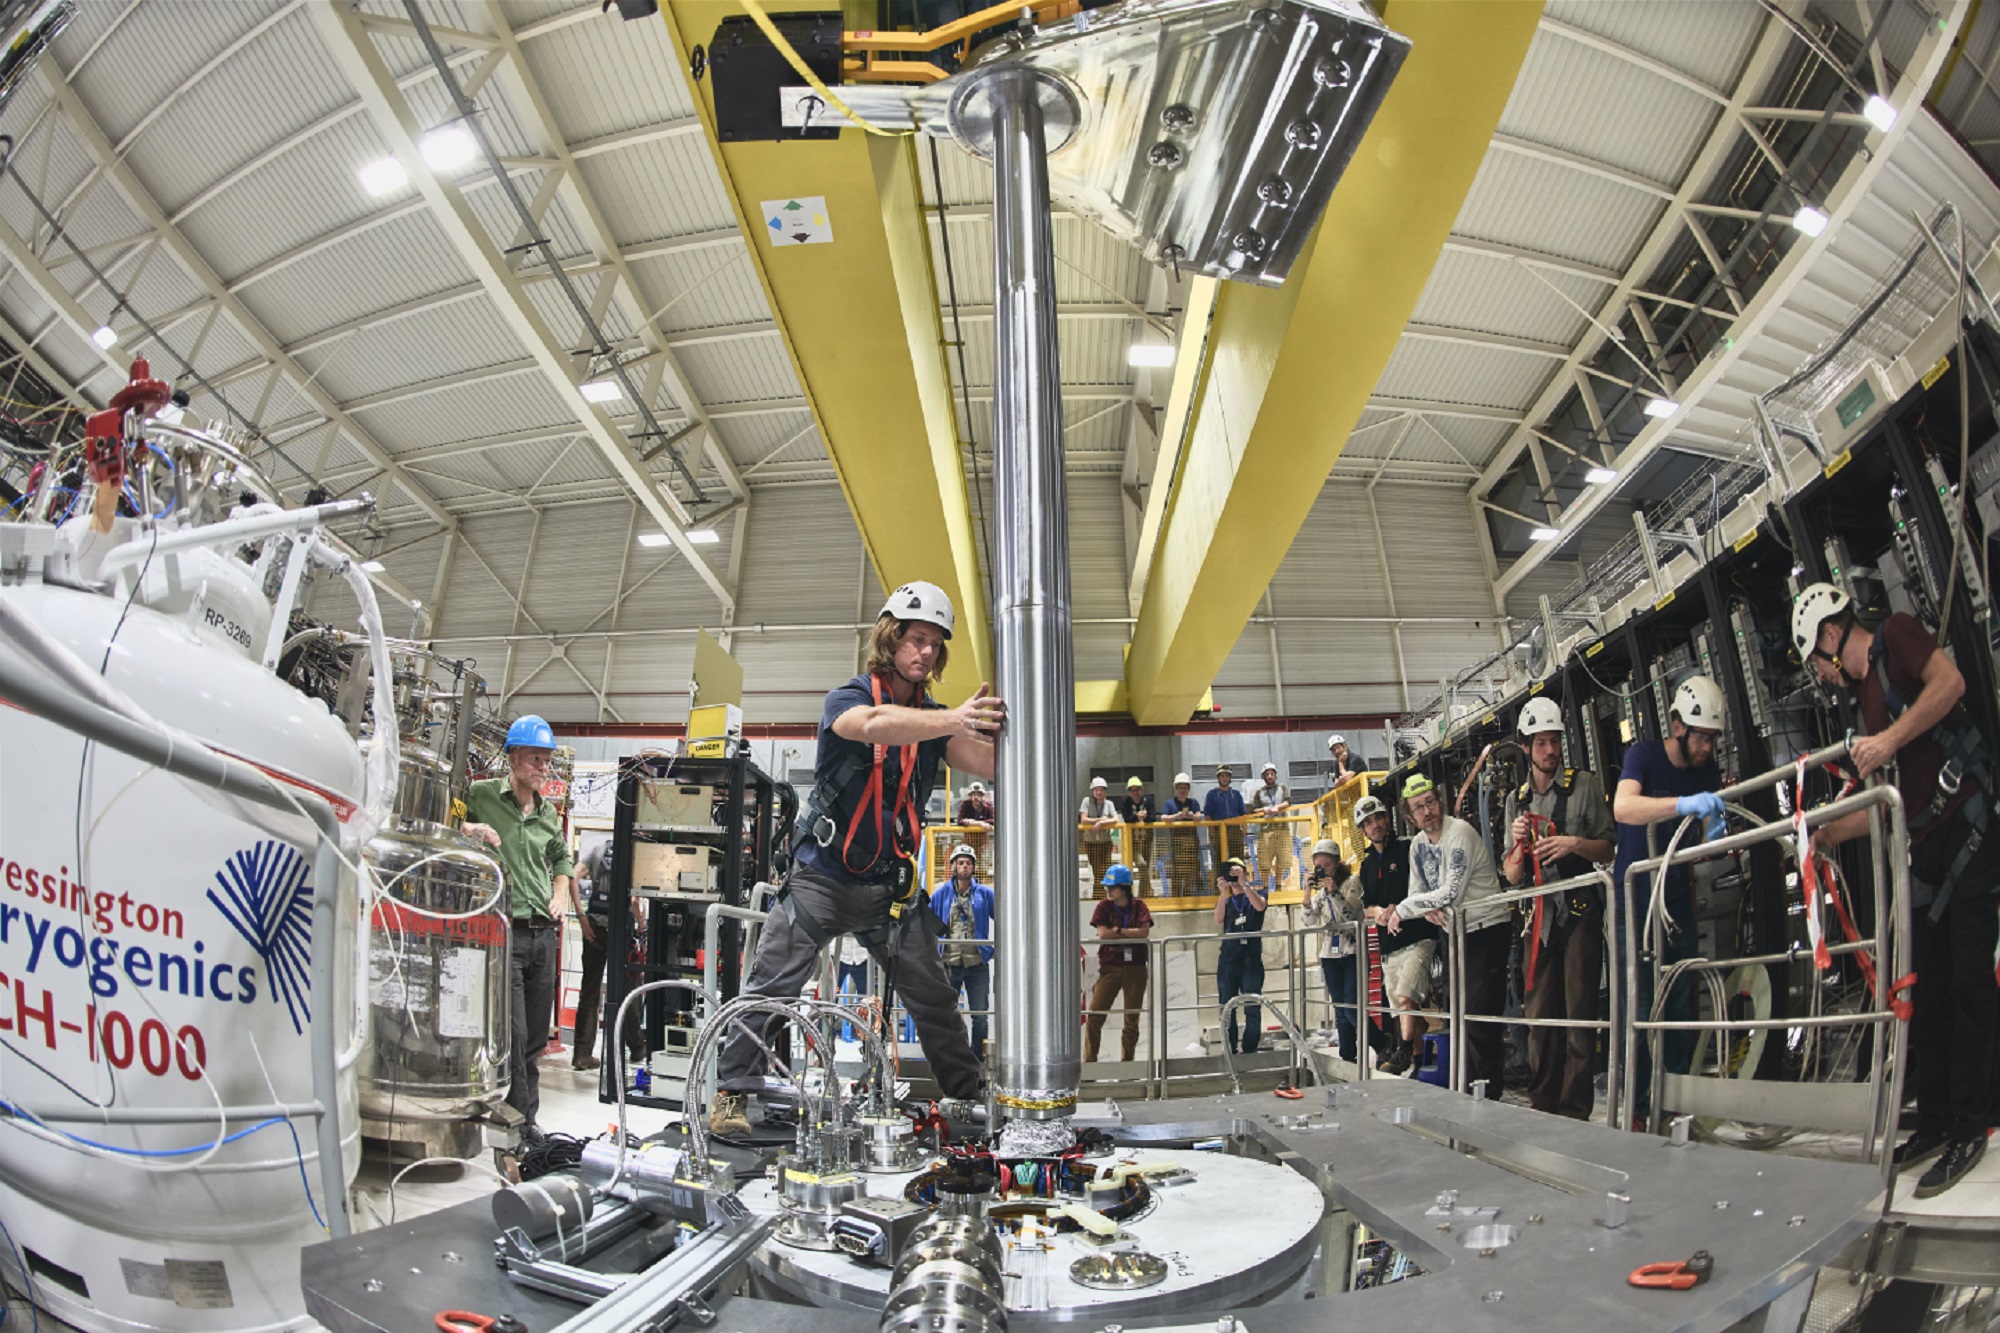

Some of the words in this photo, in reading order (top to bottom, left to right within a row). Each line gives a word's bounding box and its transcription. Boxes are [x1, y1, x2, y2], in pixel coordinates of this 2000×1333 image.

[205, 607, 252, 649] RP-3269
[0, 856, 184, 940] essington
[0, 902, 257, 1004] ryogenics
